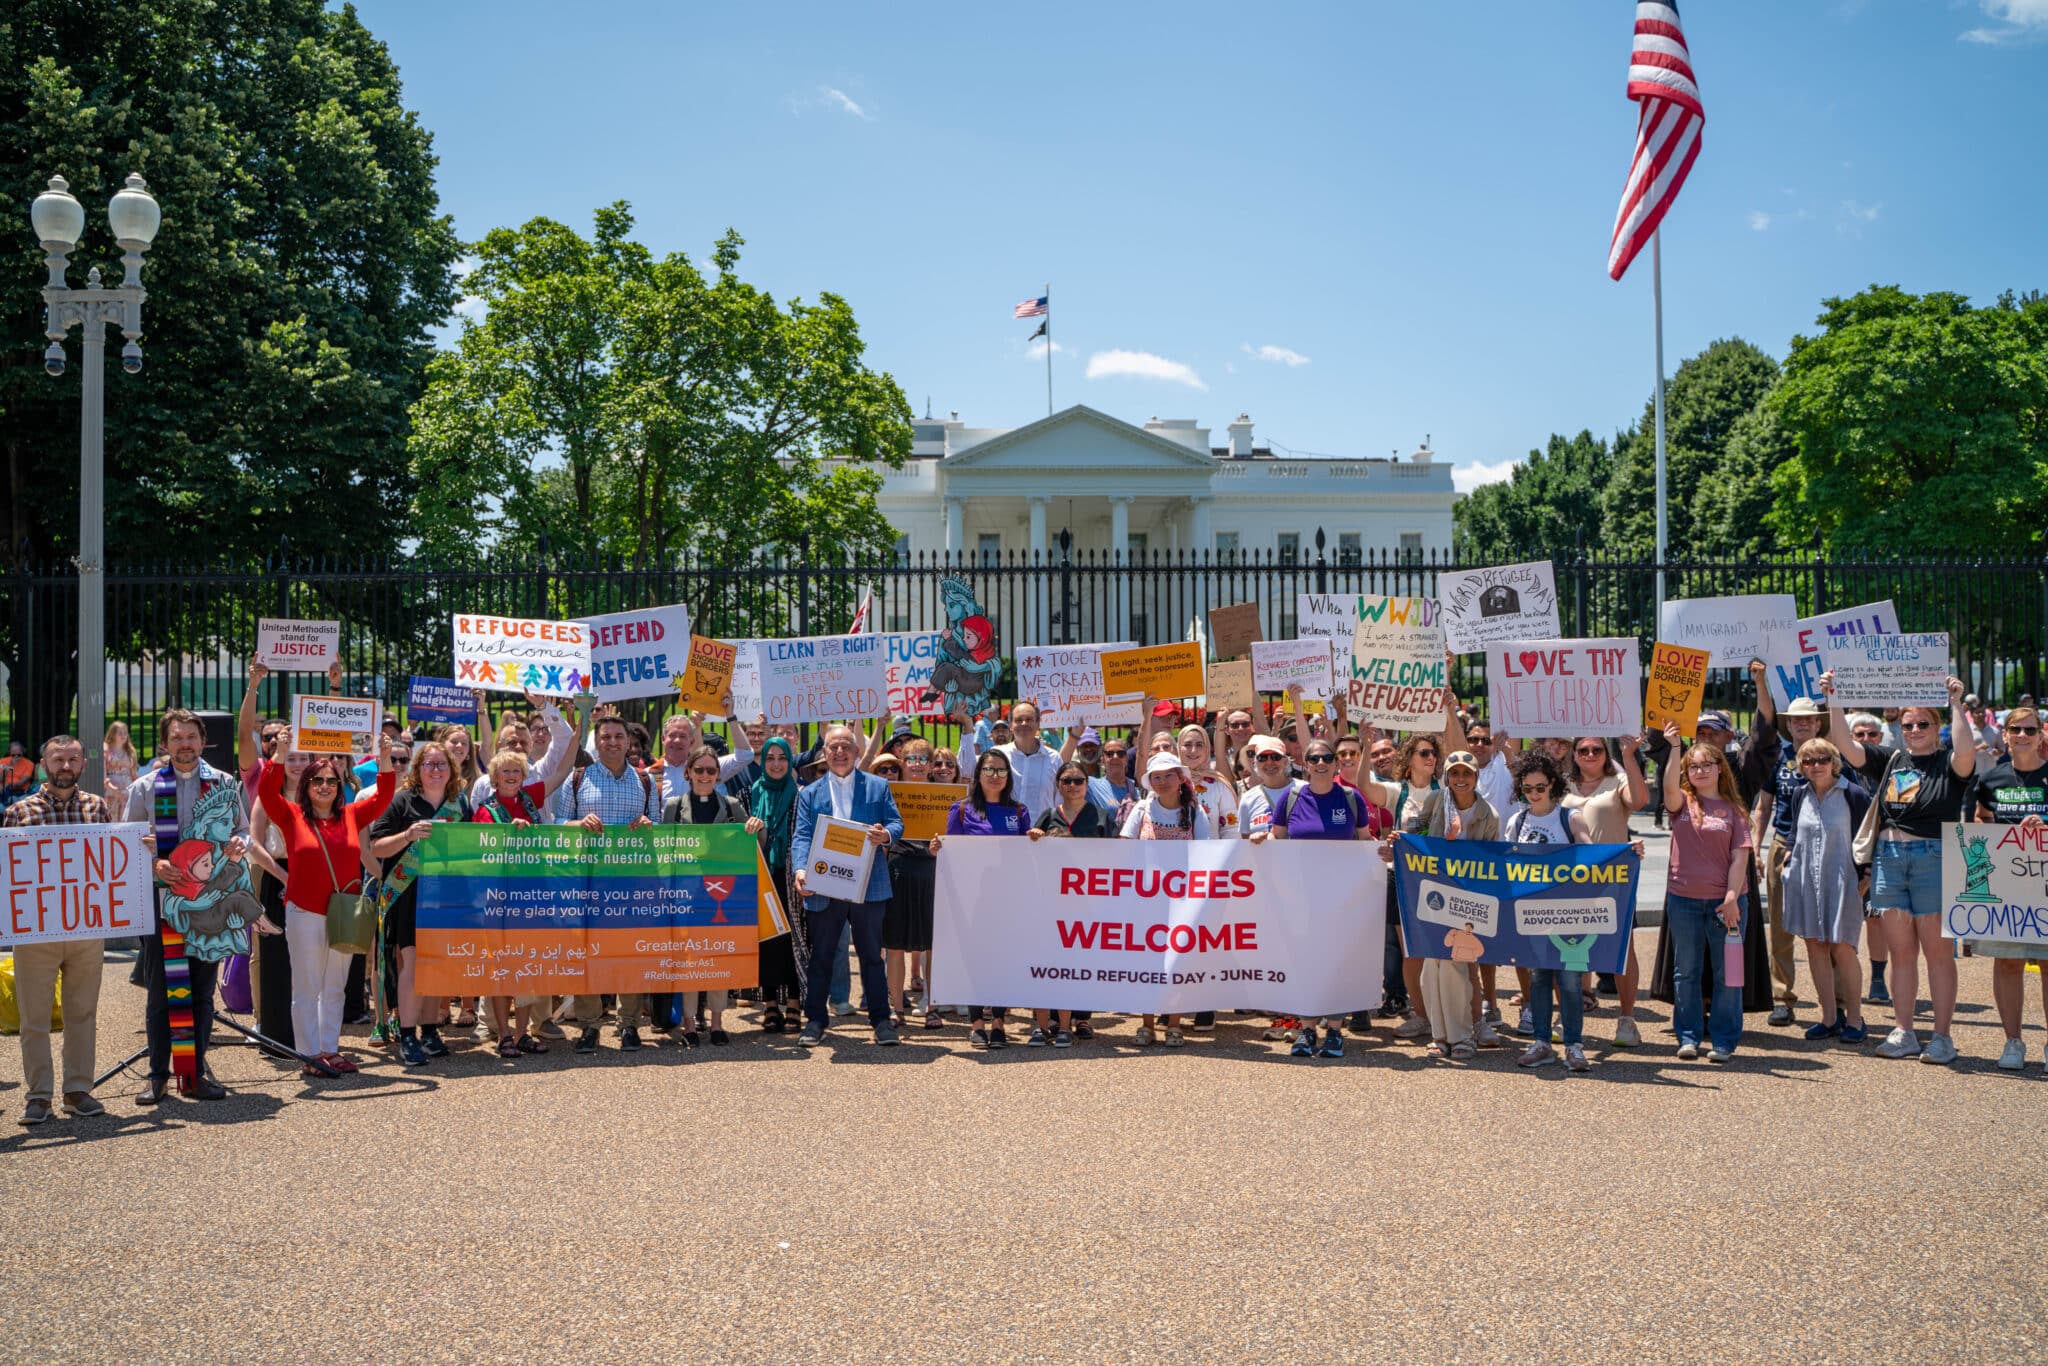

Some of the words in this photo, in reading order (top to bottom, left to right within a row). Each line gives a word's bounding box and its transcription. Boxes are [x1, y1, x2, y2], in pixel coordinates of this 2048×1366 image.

[1309, 595, 1342, 616] When
[262, 624, 290, 632] United
[292, 625, 337, 634] Methodists
[459, 618, 582, 644] REFUGEES
[1300, 622, 1332, 636] welcome
[1337, 621, 1355, 636] the
[1676, 607, 1749, 640] IMMIGRANTS
[1759, 619, 1793, 632] MAKE
[307, 634, 320, 642] for
[590, 620, 665, 649] DEFEND
[1827, 634, 1849, 650] OUR
[1854, 634, 1880, 649] FAITH
[1885, 633, 1948, 649] WELCOMES
[272, 643, 326, 656] JUSTICE
[694, 640, 732, 662] LOVE
[768, 641, 815, 661] LEARN
[1867, 648, 1920, 662] REFUGEES
[690, 659, 729, 676] BORDERS
[692, 653, 719, 665] KNOWS
[720, 660, 730, 668] NO
[772, 663, 809, 675] SEEK
[817, 659, 874, 671] JUSTICE
[1122, 658, 1143, 667] right,
[1586, 648, 1627, 676] THY
[1657, 649, 1705, 671] LOVE
[592, 654, 669, 688] REFUGE
[1110, 668, 1138, 677] defend
[1154, 661, 1195, 672] oppressed
[1290, 664, 1326, 677] BILLION
[1351, 654, 1445, 688] WELCOME
[1655, 664, 1687, 677] KNOWS
[1688, 669, 1701, 679] NO
[793, 670, 844, 685] DEFEND
[1022, 673, 1047, 689] WE
[1654, 671, 1701, 688] BORDERS
[412, 685, 434, 694] DON'T
[435, 686, 462, 697] DEPORT
[1348, 680, 1446, 713] REFUGEES!
[411, 694, 473, 708] Neighbors
[770, 688, 879, 719] OPPRESSED
[1496, 678, 1624, 726] NEIGHBOR
[307, 702, 368, 718] Refugees
[319, 717, 363, 727] Welcome
[908, 792, 928, 800] seek
[1996, 789, 2042, 801] Refugees
[1997, 803, 2018, 812] have
[2019, 804, 2026, 812] a
[480, 832, 497, 847] No
[502, 833, 550, 850] importa
[555, 833, 570, 848] de
[575, 833, 612, 848] donde
[617, 836, 648, 850] eres,
[653, 834, 700, 848] estamos
[0, 836, 129, 886] EFEND
[482, 852, 541, 865] contentos
[546, 854, 569, 867] que
[574, 854, 599, 864] seas
[604, 852, 652, 864] nuestro
[656, 853, 698, 864] vecino.
[829, 864, 854, 878] CWS
[1405, 853, 1439, 875] WE
[1445, 859, 1499, 881] WILL
[1506, 863, 1629, 884] WELCOME
[1060, 867, 1256, 899] REFUGEES
[486, 888, 507, 901] No
[510, 889, 556, 901] matter
[560, 888, 600, 900] where
[604, 890, 629, 902] you
[633, 890, 655, 900] are
[658, 888, 692, 900] from,
[0, 881, 131, 934] EFUGE
[484, 906, 521, 916] we're
[525, 904, 556, 919] glad
[560, 905, 600, 919] you're
[604, 907, 628, 917] our
[632, 904, 695, 919] neighbor.
[1449, 902, 1489, 919] LEADERS
[1450, 896, 1490, 911] ADVOCACY
[1523, 916, 1580, 925] ADVOCACY
[1582, 915, 1609, 924] DAYS
[635, 938, 736, 952] GreaterAs1.org
[1056, 920, 1258, 954] WELCOME
[528, 949, 537, 959] و
[591, 943, 601, 956] لا
[659, 958, 715, 969] #GreaterAs1
[644, 970, 731, 981] #RefugeesWelcome
[1030, 966, 1092, 982] WORLD
[1097, 970, 1168, 984] REFUGEE
[1172, 972, 1206, 985] DAY
[1221, 969, 1263, 982] JUNE
[1268, 970, 1286, 984] 20
